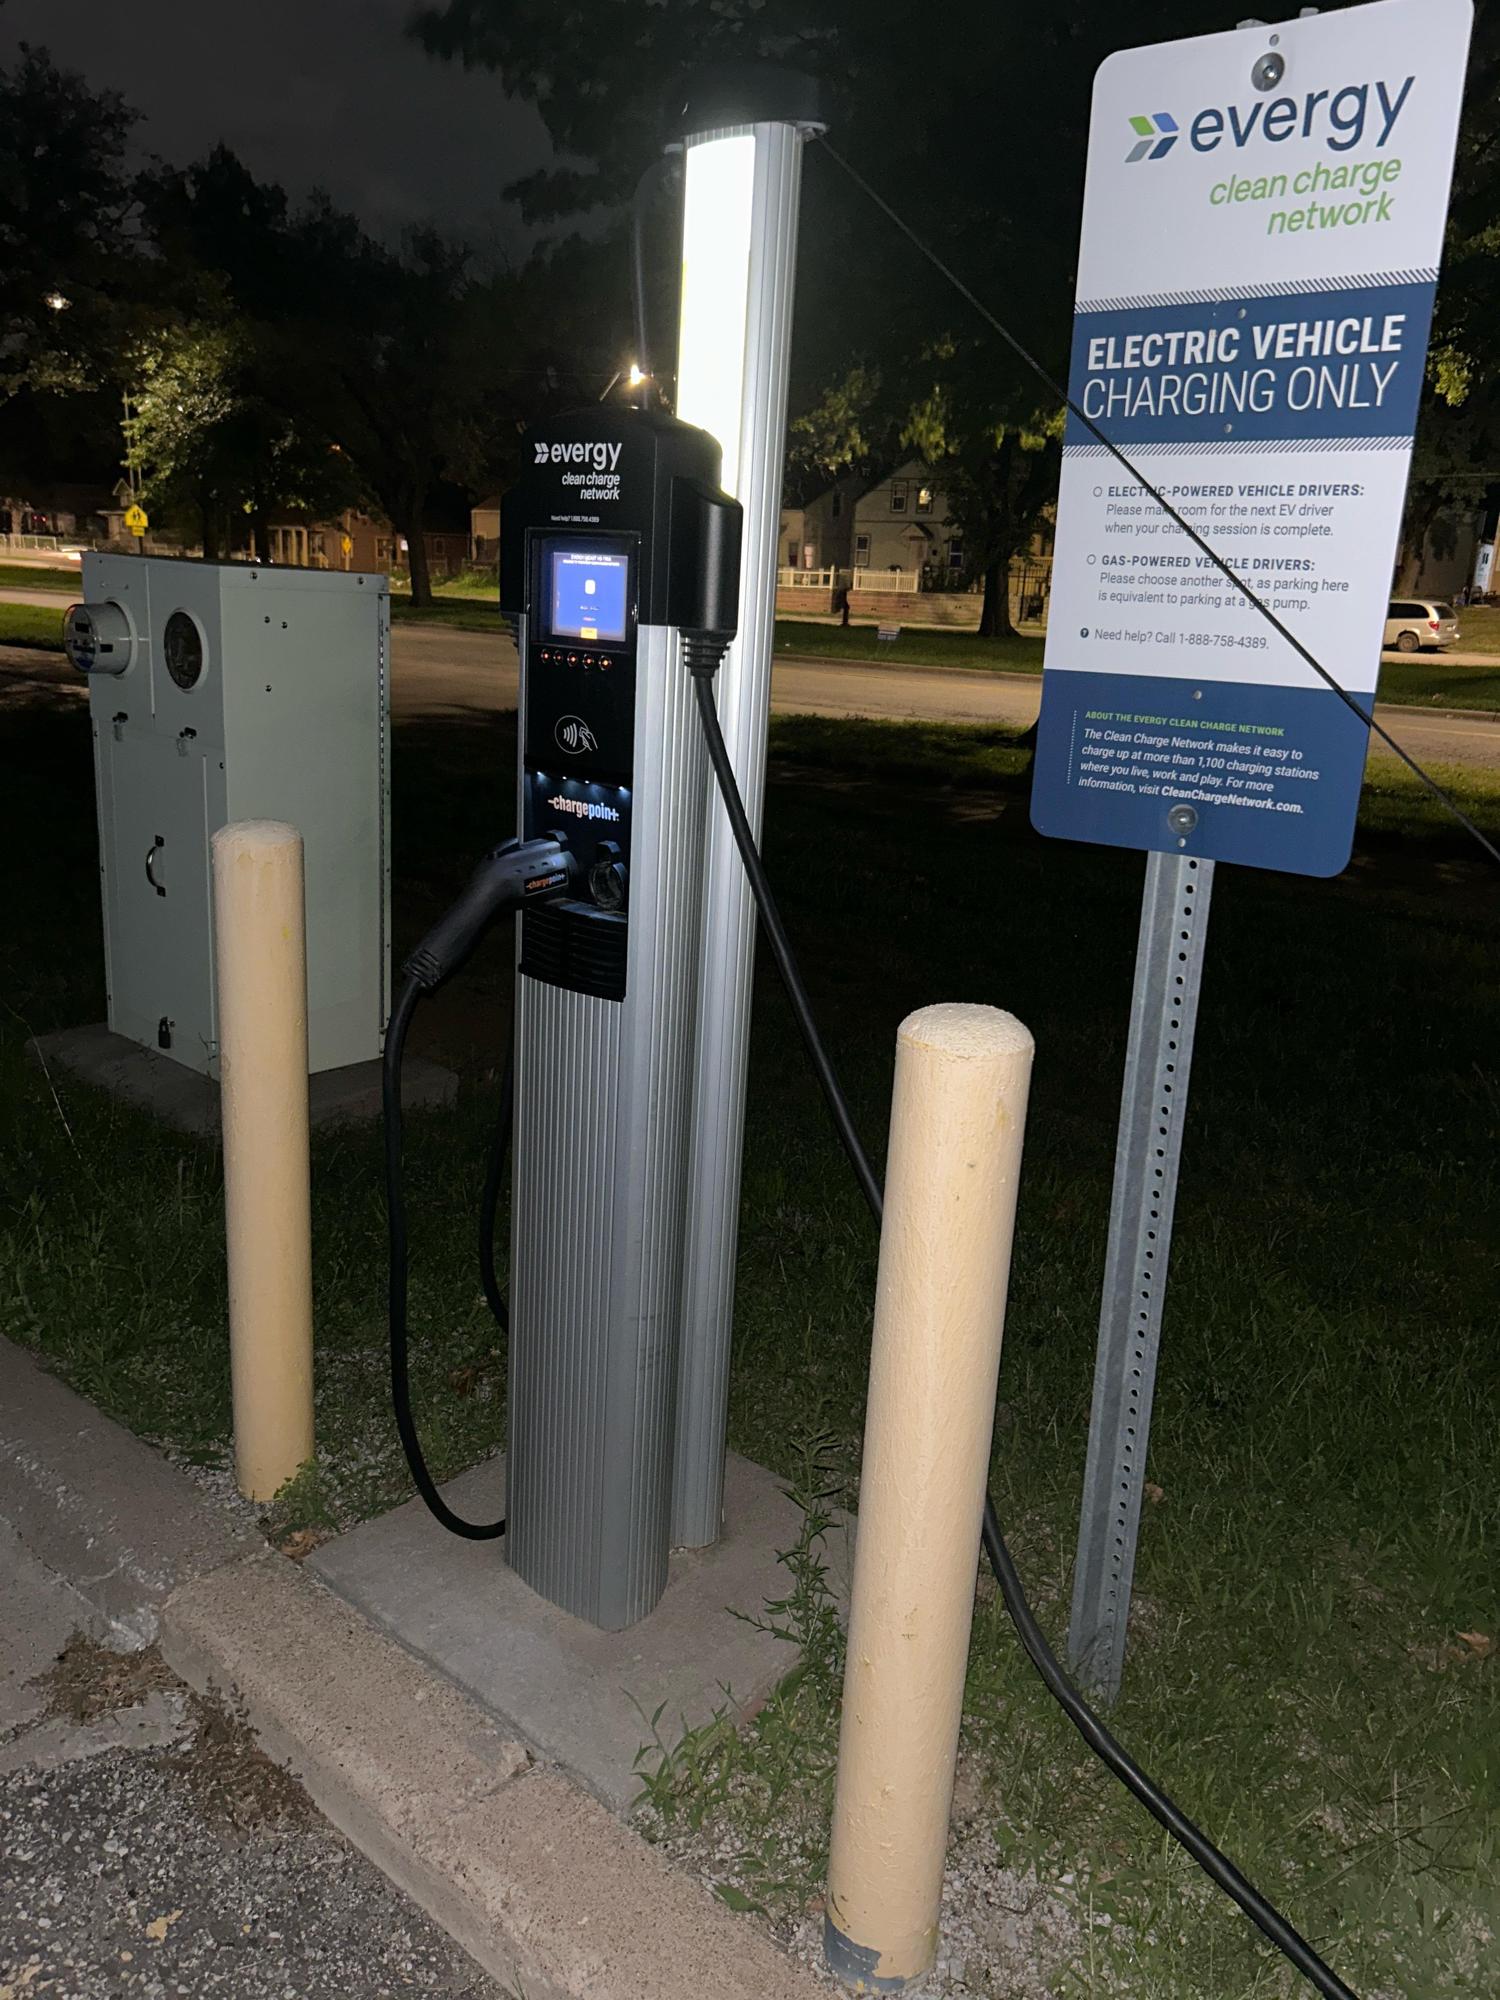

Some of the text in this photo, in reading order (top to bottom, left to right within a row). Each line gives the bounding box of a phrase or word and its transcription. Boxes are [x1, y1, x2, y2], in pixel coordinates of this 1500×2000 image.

[1190, 76, 1415, 153] evergy
[1210, 158, 1402, 206] clean charge
[1267, 192, 1395, 235] network
[1088, 314, 1406, 371] ELECTRIC VEHICLE
[1082, 362, 1399, 420] CHARGING ONLY
[551, 442, 623, 471] evergy
[562, 472, 620, 489] clean charge
[580, 487, 620, 500] network
[1238, 485, 1295, 497] VEHICLE
[1298, 484, 1365, 496] DRIVERS:
[1106, 504, 1334, 517] Please ma room for the next EV driver
[1105, 522, 1133, 534] when
[1135, 525, 1160, 537] your
[1212, 523, 1257, 535] session
[1260, 523, 1271, 535] is
[1273, 523, 1334, 538] complete.
[1102, 555, 1191, 568] GAS-POWERED
[1253, 558, 1315, 571] DRIVERS:
[1100, 572, 1135, 584] Please
[1138, 573, 1177, 586] choose
[1180, 575, 1223, 587] another
[1257, 580, 1271, 589] as
[1273, 578, 1319, 593] parking
[1321, 579, 1349, 592] here
[1098, 590, 1108, 601] is
[1110, 591, 1164, 604] equivalent
[1167, 593, 1178, 604] to
[1180, 593, 1221, 608] parking
[1224, 596, 1236, 606] at
[1239, 598, 1245, 607] a
[1273, 599, 1310, 612] pump.
[1094, 629, 1269, 650] Need help? Call 1-888-758-4389.
[1085, 711, 1285, 736] ABOUT THE EVERGY CLEAN CHARGE NETWORK
[1084, 728, 1303, 761] The Clean Charge Network makes it easy to
[1081, 745, 1320, 780] charge up at more than 1,100 charging stations
[1080, 761, 1274, 792] where you live, work and play. For more
[1078, 777, 1304, 813] information, visit CleanChargeNetwork.com.
